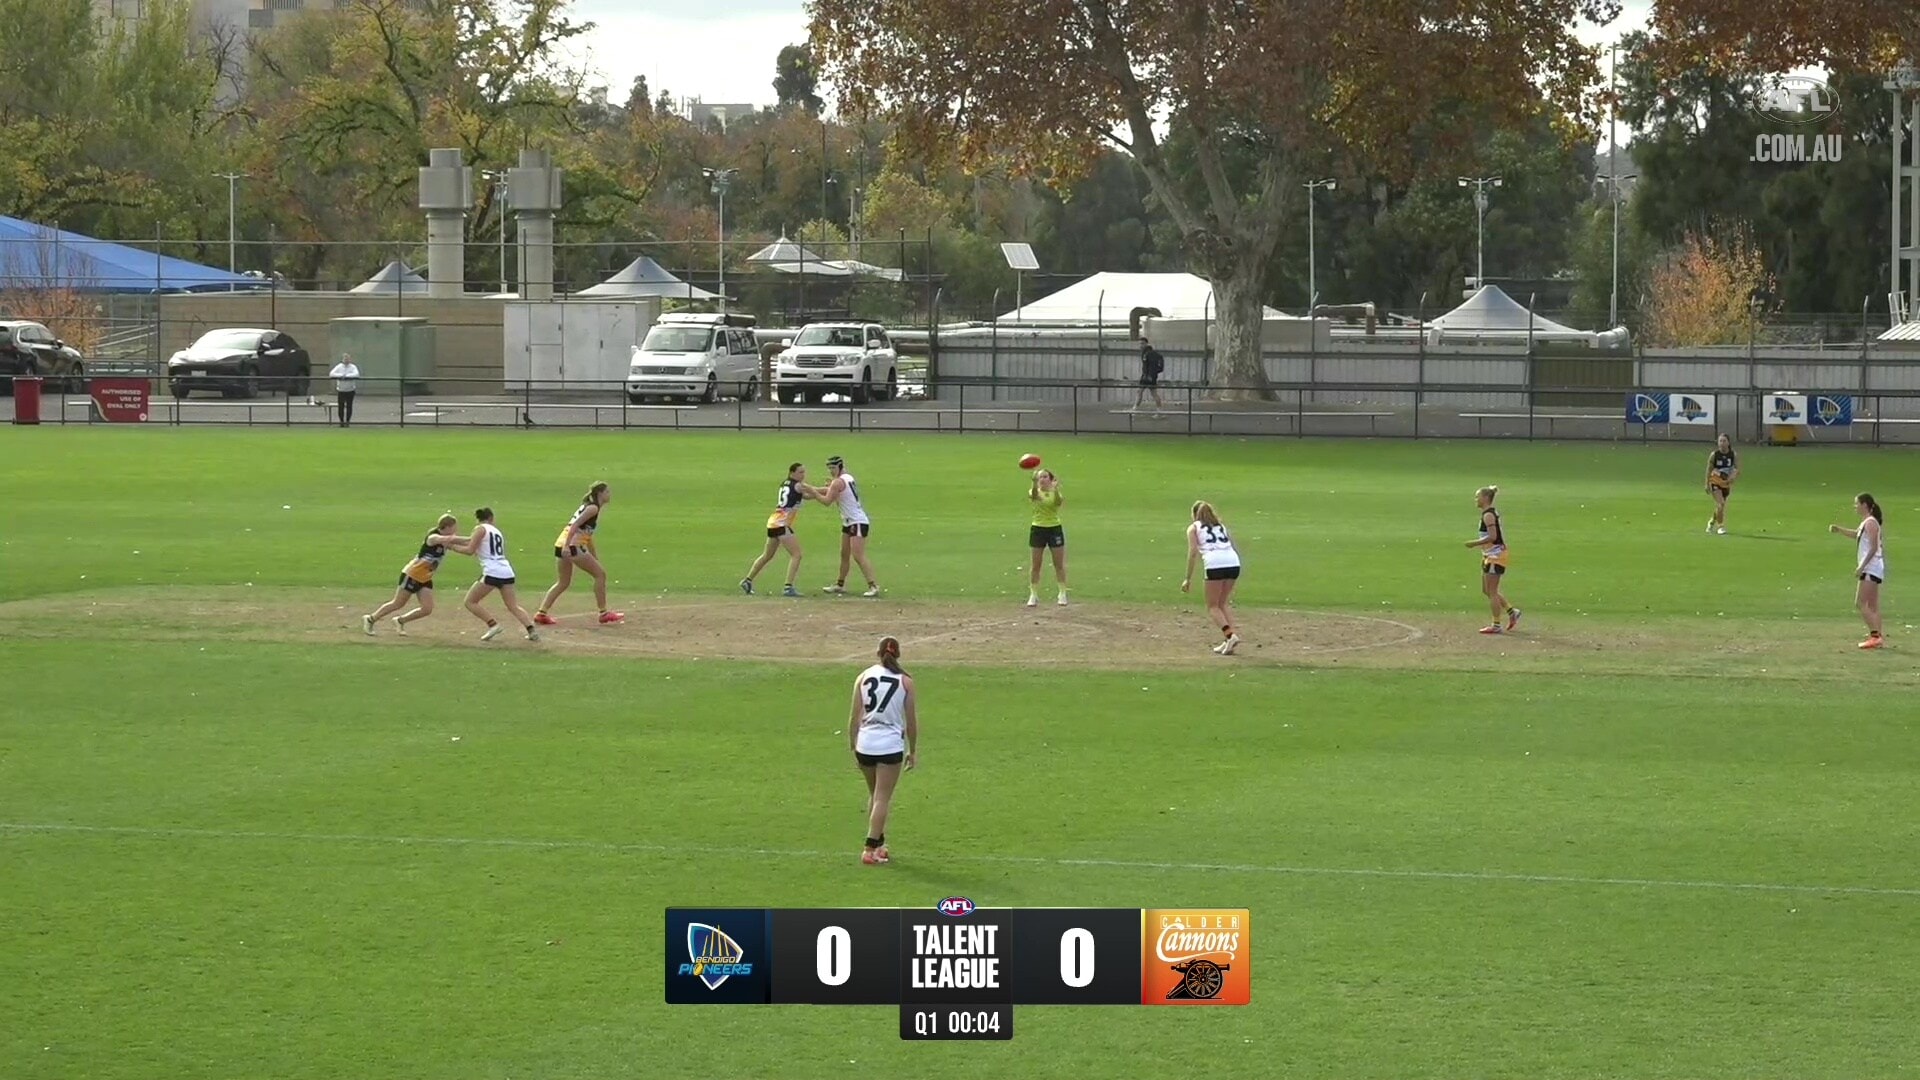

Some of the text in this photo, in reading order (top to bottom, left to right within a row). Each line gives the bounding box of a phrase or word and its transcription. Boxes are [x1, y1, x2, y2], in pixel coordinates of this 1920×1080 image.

[489, 531, 504, 557] 18
[1200, 523, 1229, 544] 33
[863, 675, 900, 713] 37
